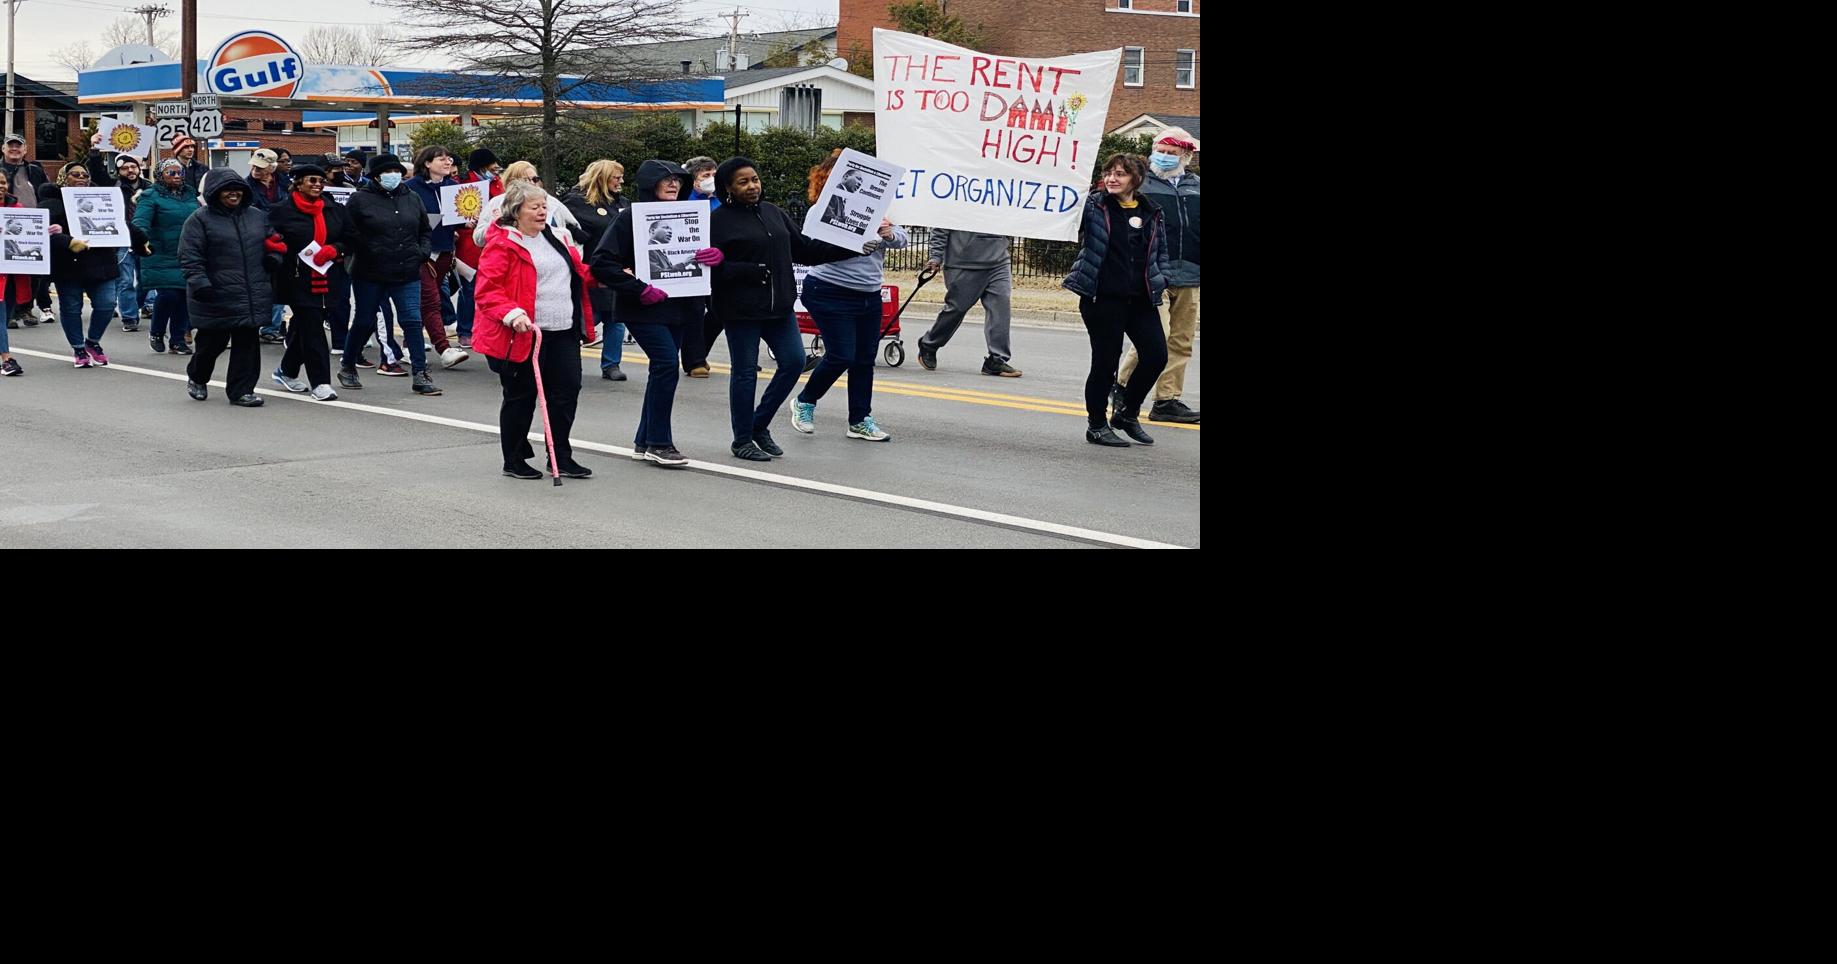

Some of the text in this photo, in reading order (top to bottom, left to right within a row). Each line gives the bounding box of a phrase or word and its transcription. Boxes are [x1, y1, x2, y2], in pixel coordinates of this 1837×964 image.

[215, 57, 297, 92] Gulf
[883, 54, 1081, 96] THE RENT
[157, 105, 187, 114] NORTH
[192, 96, 217, 106] NORTH
[885, 89, 904, 111] IS
[914, 89, 969, 113] TOO
[160, 124, 186, 142] 25
[193, 116, 217, 133] 421
[878, 180, 888, 188] The
[895, 169, 926, 199] ET
[930, 172, 1080, 213] ORGANIZED
[849, 209, 872, 222] Struggle
[865, 206, 875, 214] The
